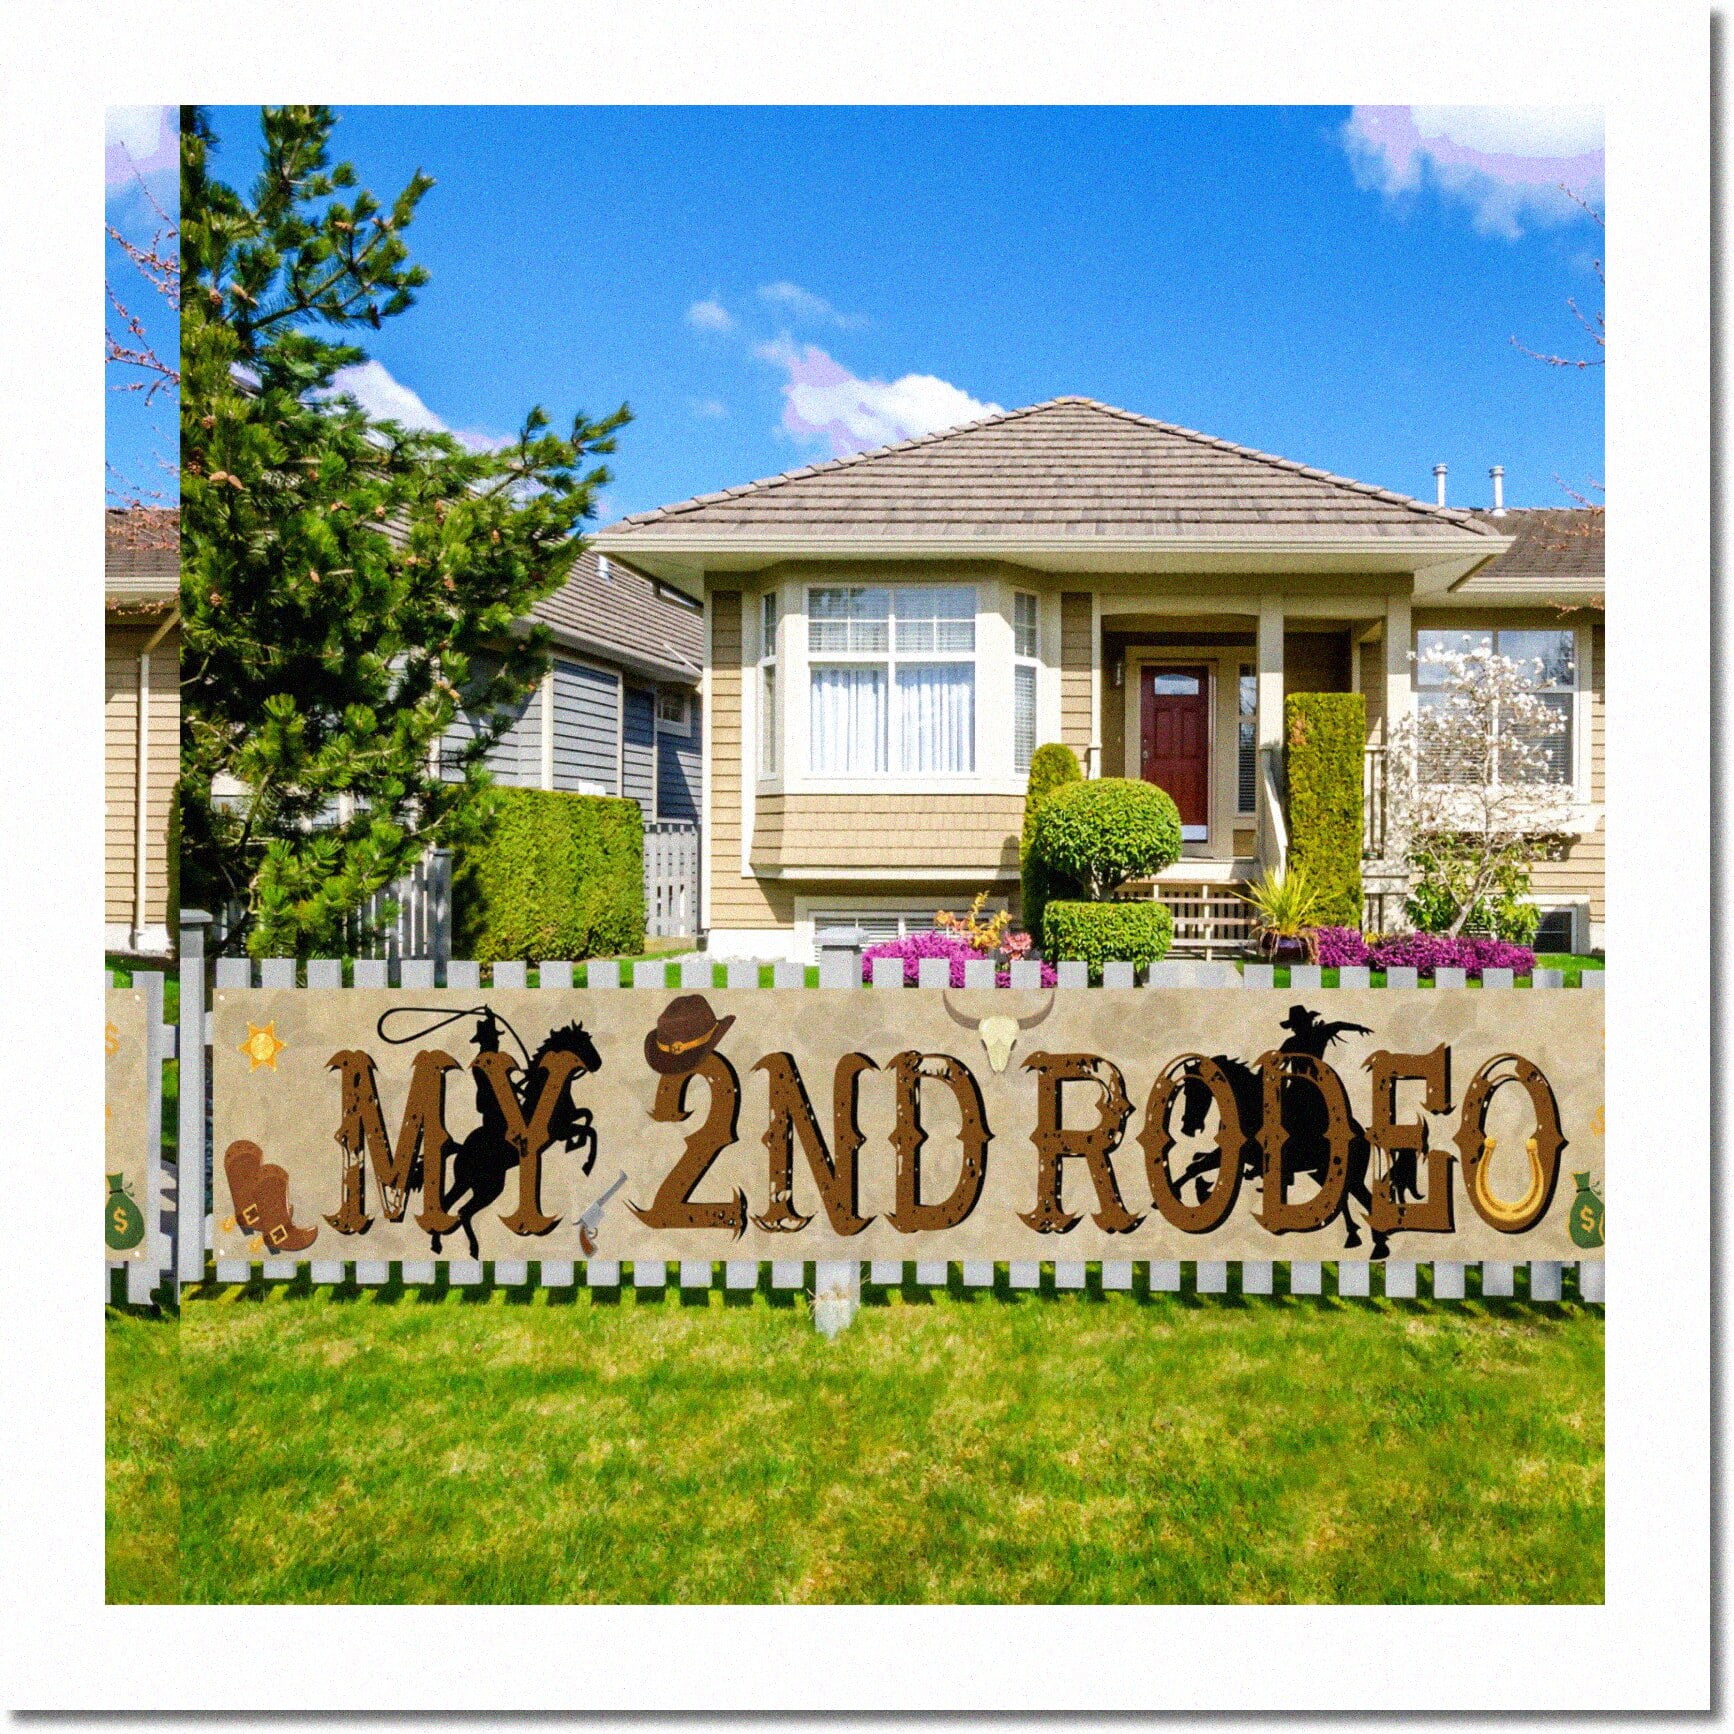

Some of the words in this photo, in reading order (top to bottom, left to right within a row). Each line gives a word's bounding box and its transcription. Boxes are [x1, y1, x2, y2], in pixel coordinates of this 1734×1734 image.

[322, 1050, 586, 1236] MY
[625, 1050, 995, 1241] 2ND
[1016, 1042, 1569, 1235] RODEO
